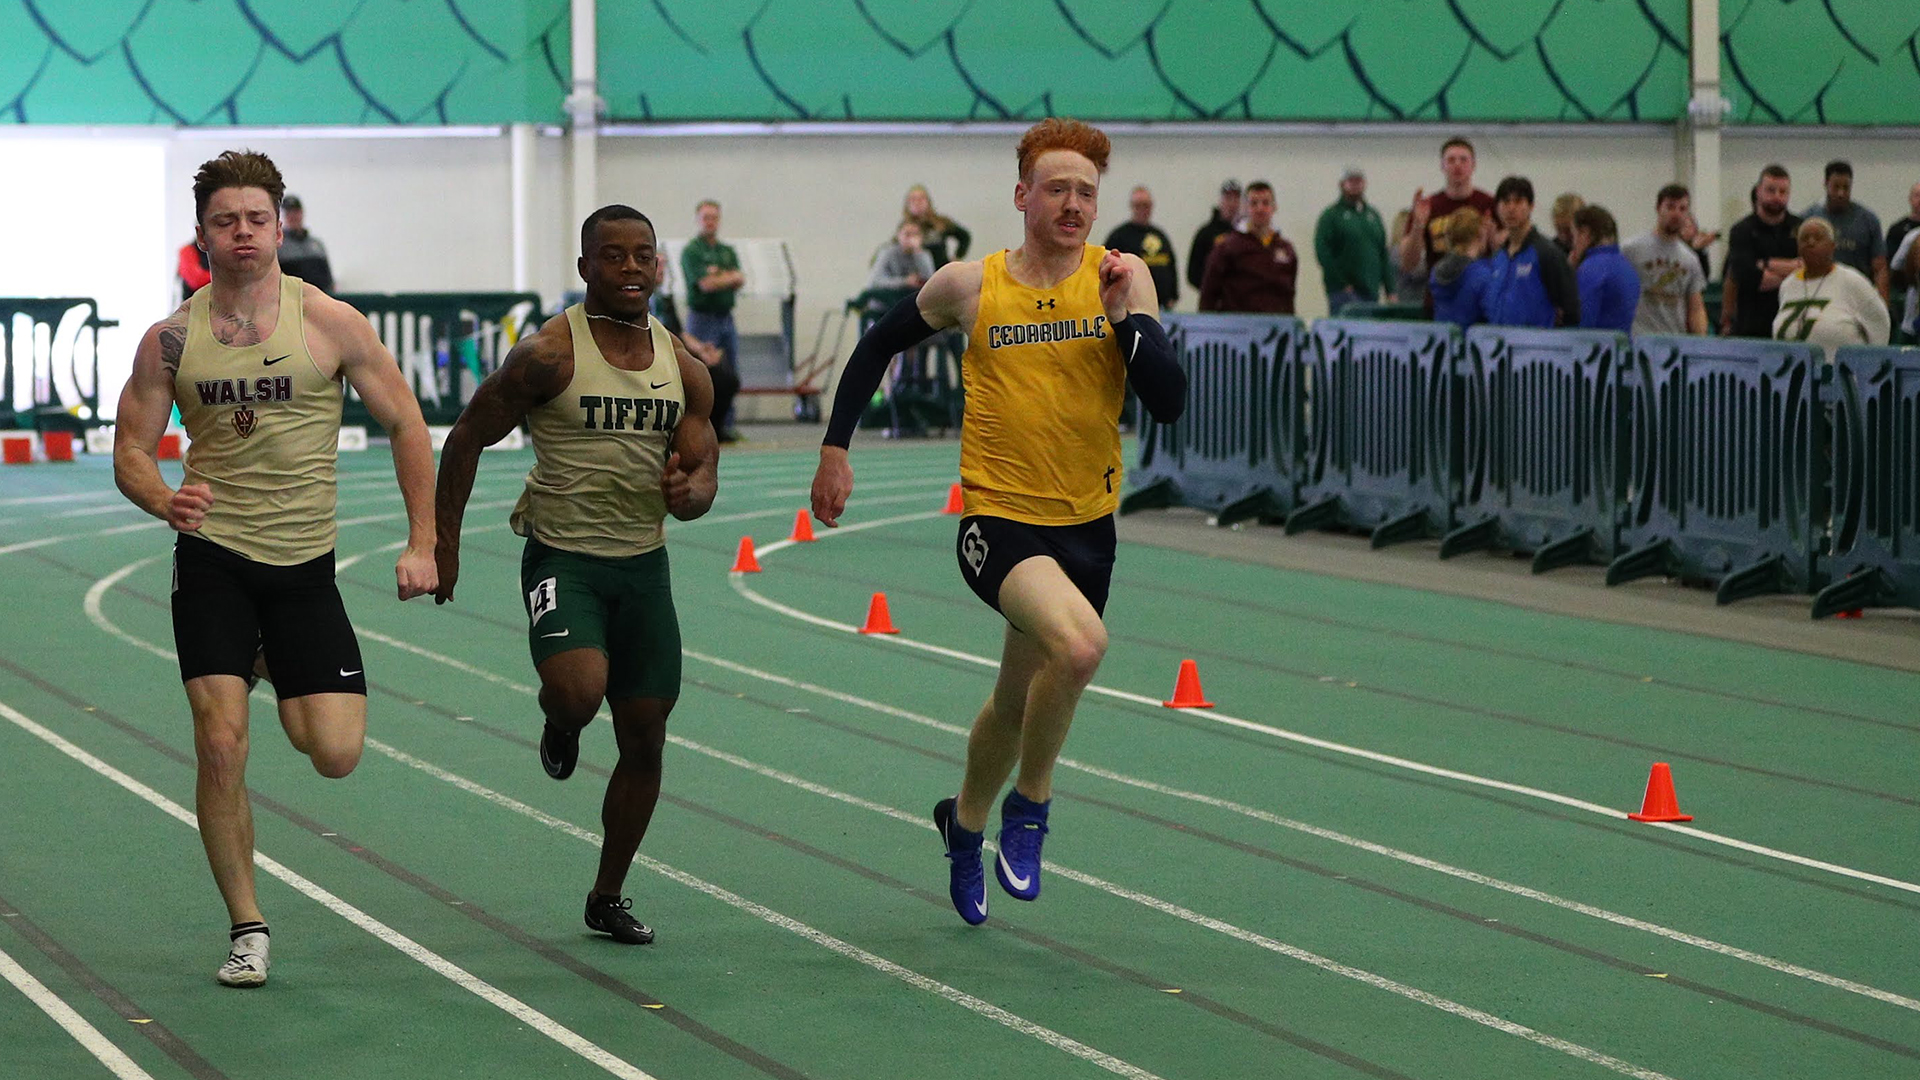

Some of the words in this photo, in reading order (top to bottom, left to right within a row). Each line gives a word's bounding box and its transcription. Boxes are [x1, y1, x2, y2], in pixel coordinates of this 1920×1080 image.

[988, 316, 1106, 349] CEDARVILLE
[195, 375, 292, 405] WALSH
[237, 411, 252, 422] W
[964, 531, 985, 569] 3
[534, 582, 550, 616] 4
